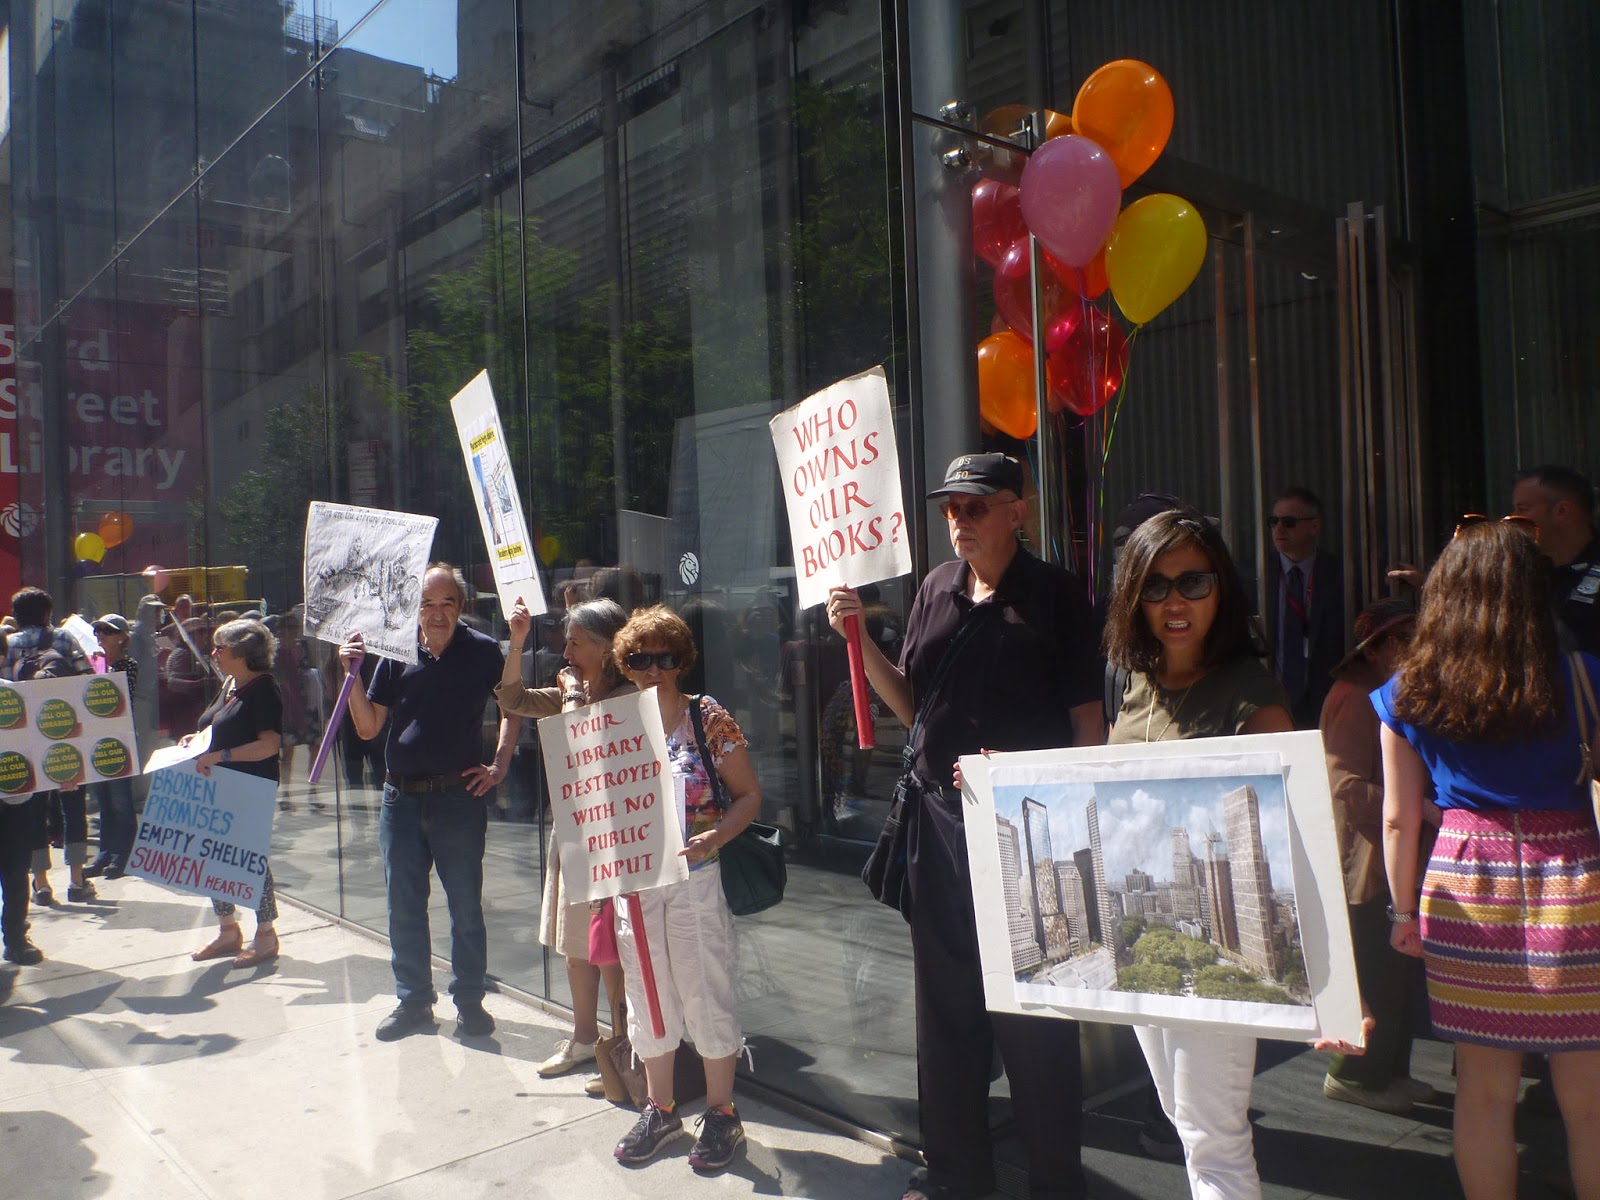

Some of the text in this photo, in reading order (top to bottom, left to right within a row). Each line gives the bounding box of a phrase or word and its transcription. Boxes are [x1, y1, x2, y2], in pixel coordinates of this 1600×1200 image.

[0, 323, 110, 372] 5rd
[0, 378, 161, 427] Steet
[793, 399, 857, 453] WHO
[793, 431, 879, 497] OWNS
[955, 470, 969, 479] 50
[809, 481, 876, 529] OUR
[802, 511, 903, 578] BOOKS?
[570, 713, 628, 739] YOUR
[564, 734, 645, 769] LIBRARY
[152, 769, 217, 805] BROKEN
[561, 760, 662, 800] DESTROYED
[145, 794, 234, 836] PROMISES
[571, 792, 655, 826] WITH NO
[138, 822, 196, 853] EMPTY
[586, 822, 653, 853] PUBLIC
[130, 846, 254, 900] SUNKEN HEARTS
[592, 853, 655, 882] INPUT
